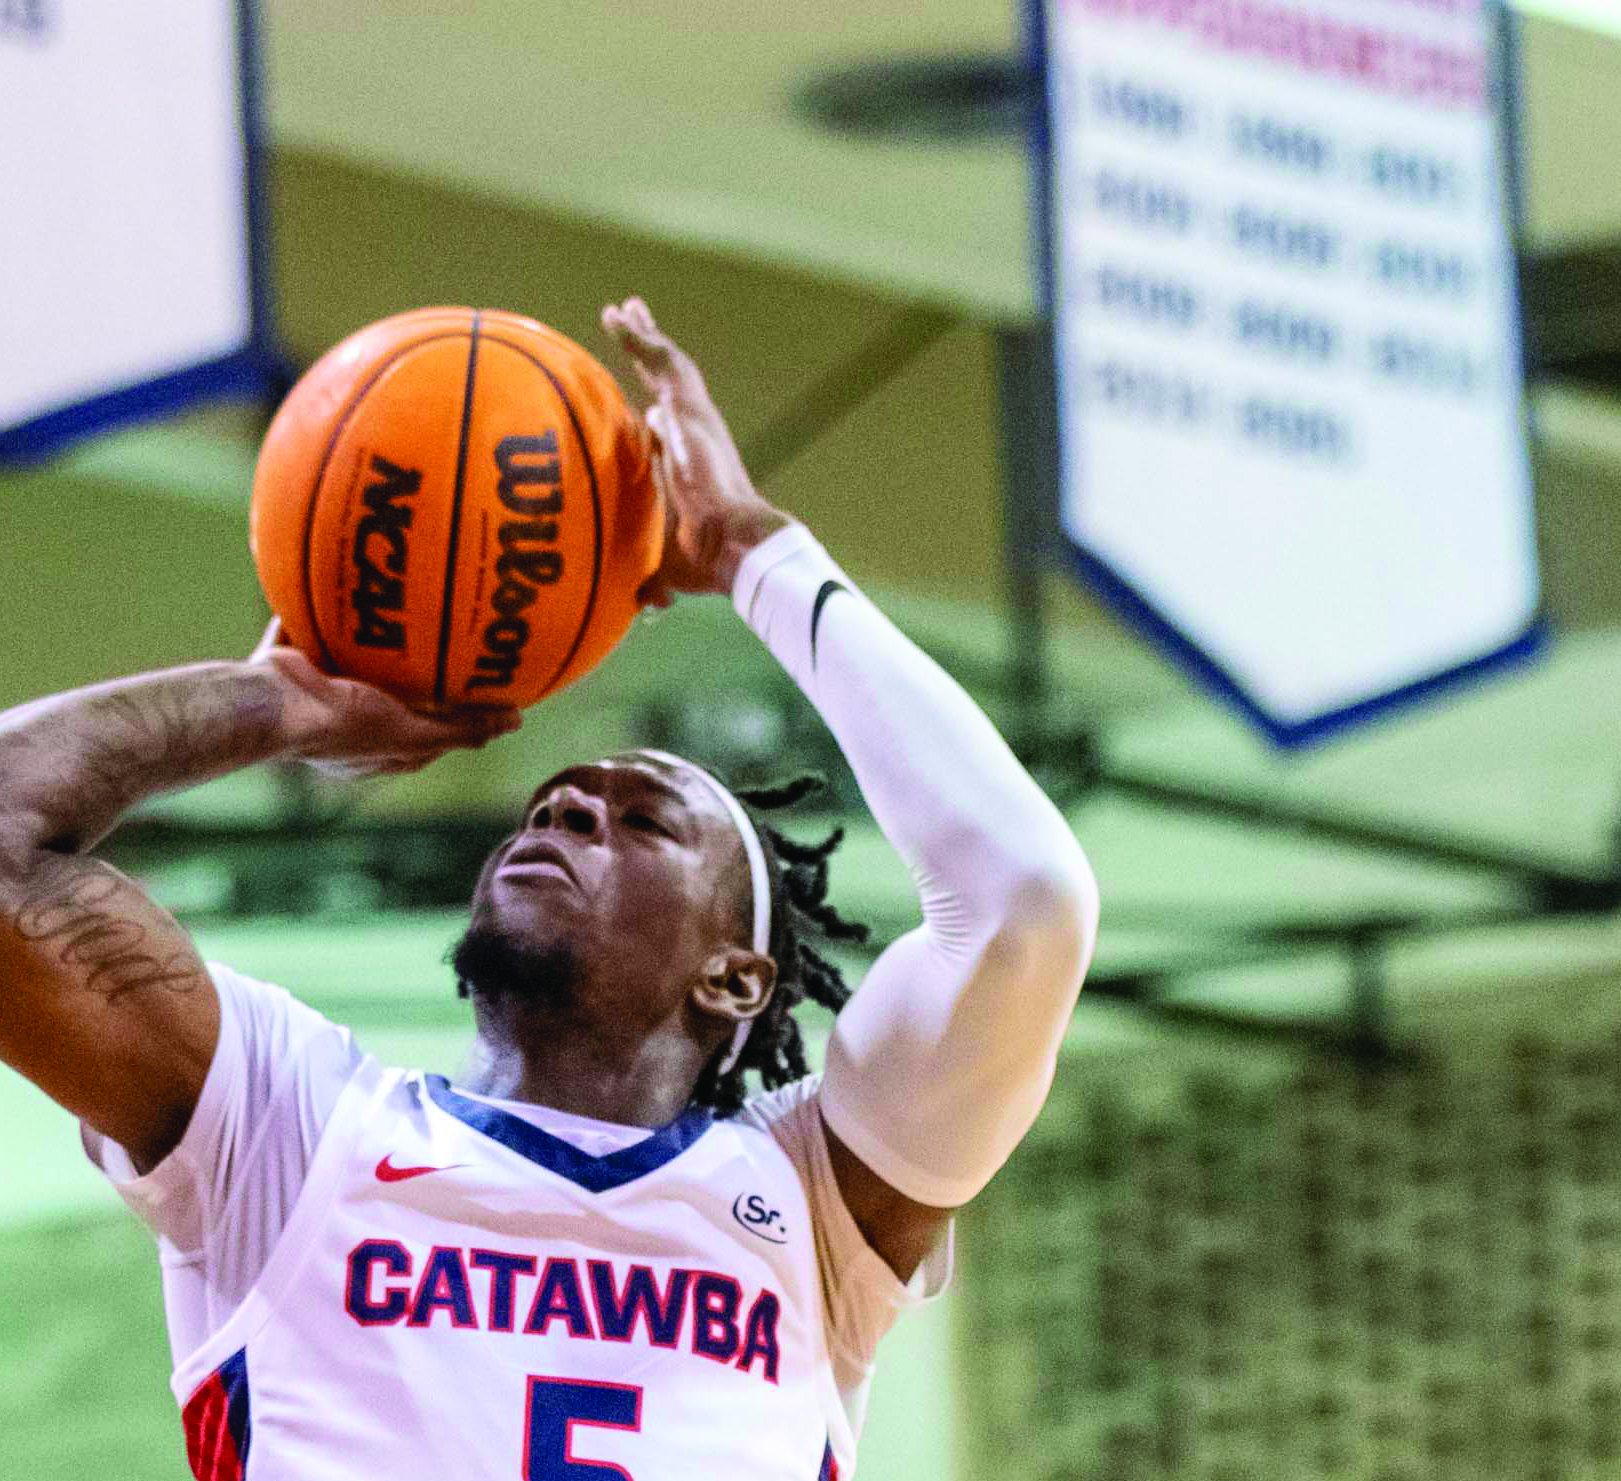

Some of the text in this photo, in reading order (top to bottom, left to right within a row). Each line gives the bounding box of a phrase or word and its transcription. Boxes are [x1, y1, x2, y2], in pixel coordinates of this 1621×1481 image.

[352, 454, 423, 649] NCAA
[464, 429, 565, 691] Wilson
[344, 1238, 781, 1386] CATAWBA
